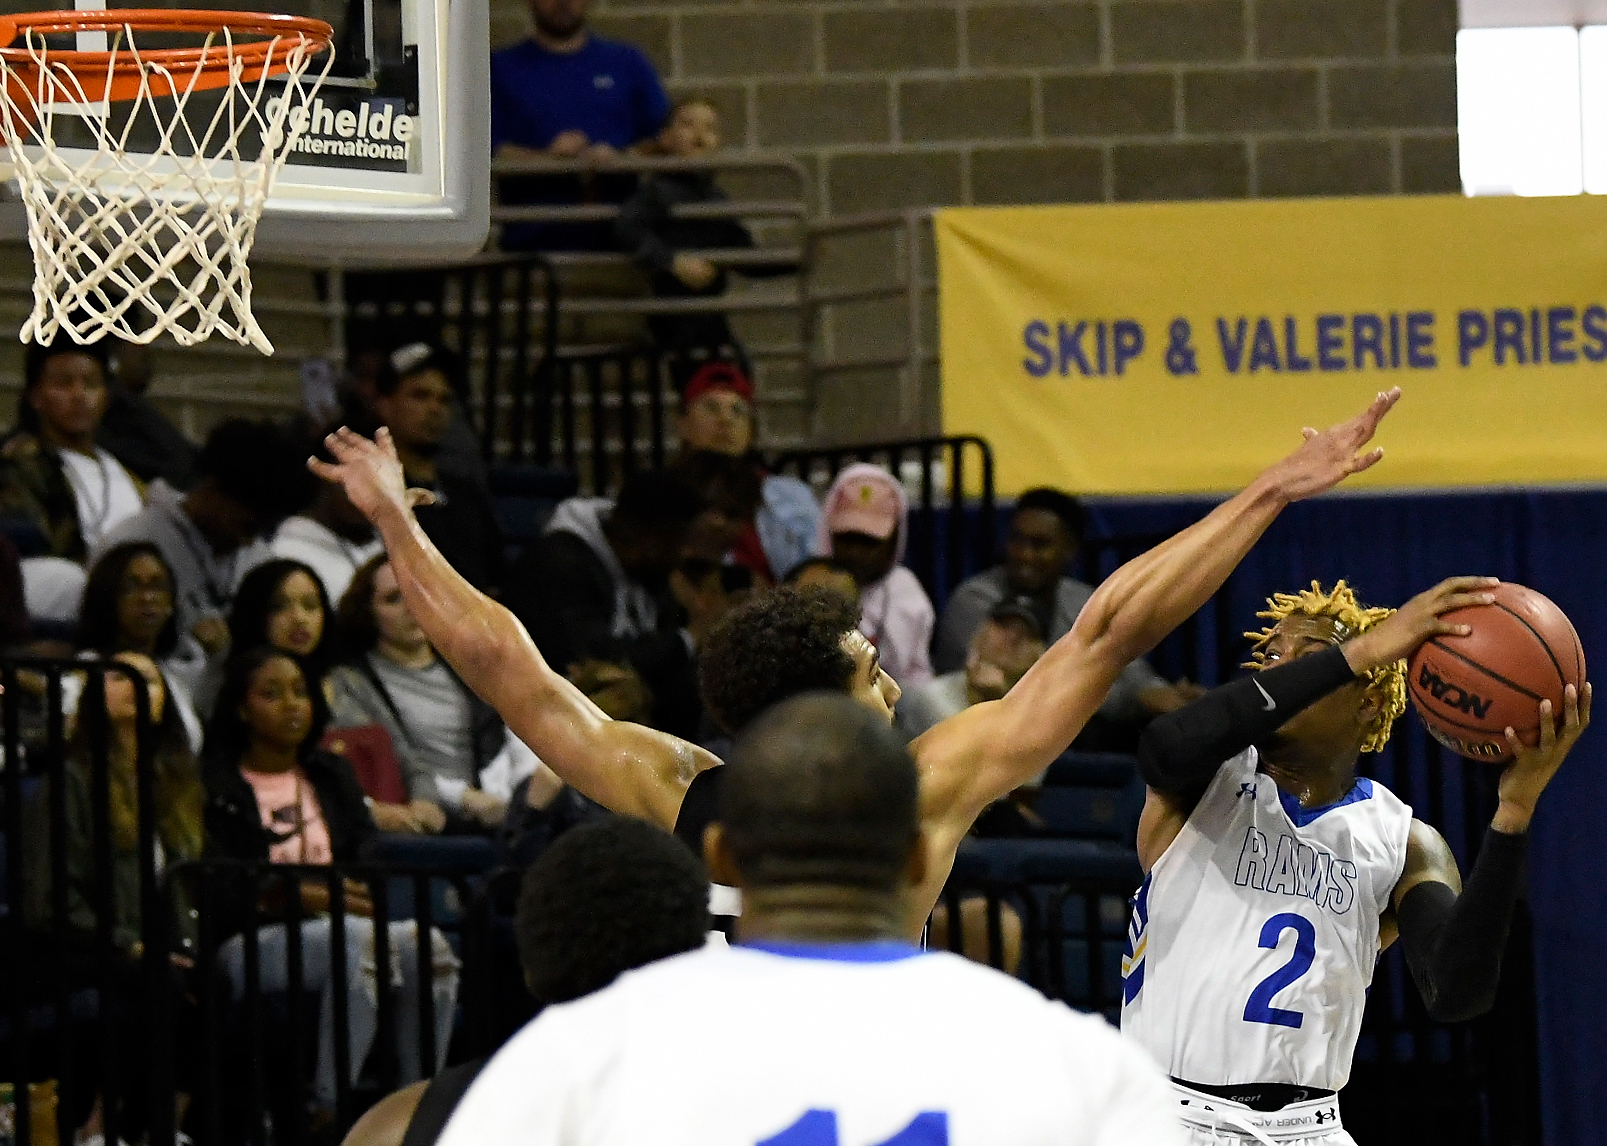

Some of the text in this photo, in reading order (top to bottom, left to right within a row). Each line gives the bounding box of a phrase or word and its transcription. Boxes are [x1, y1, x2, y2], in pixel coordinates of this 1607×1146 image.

[289, 136, 410, 160] nternational
[1022, 305, 1607, 378] SKIP & VALERIE PRIES
[1418, 662, 1493, 720] NCAA
[1234, 826, 1358, 915] RAMS
[1242, 911, 1317, 1029] 2
[1276, 1116, 1312, 1127] UNDER
